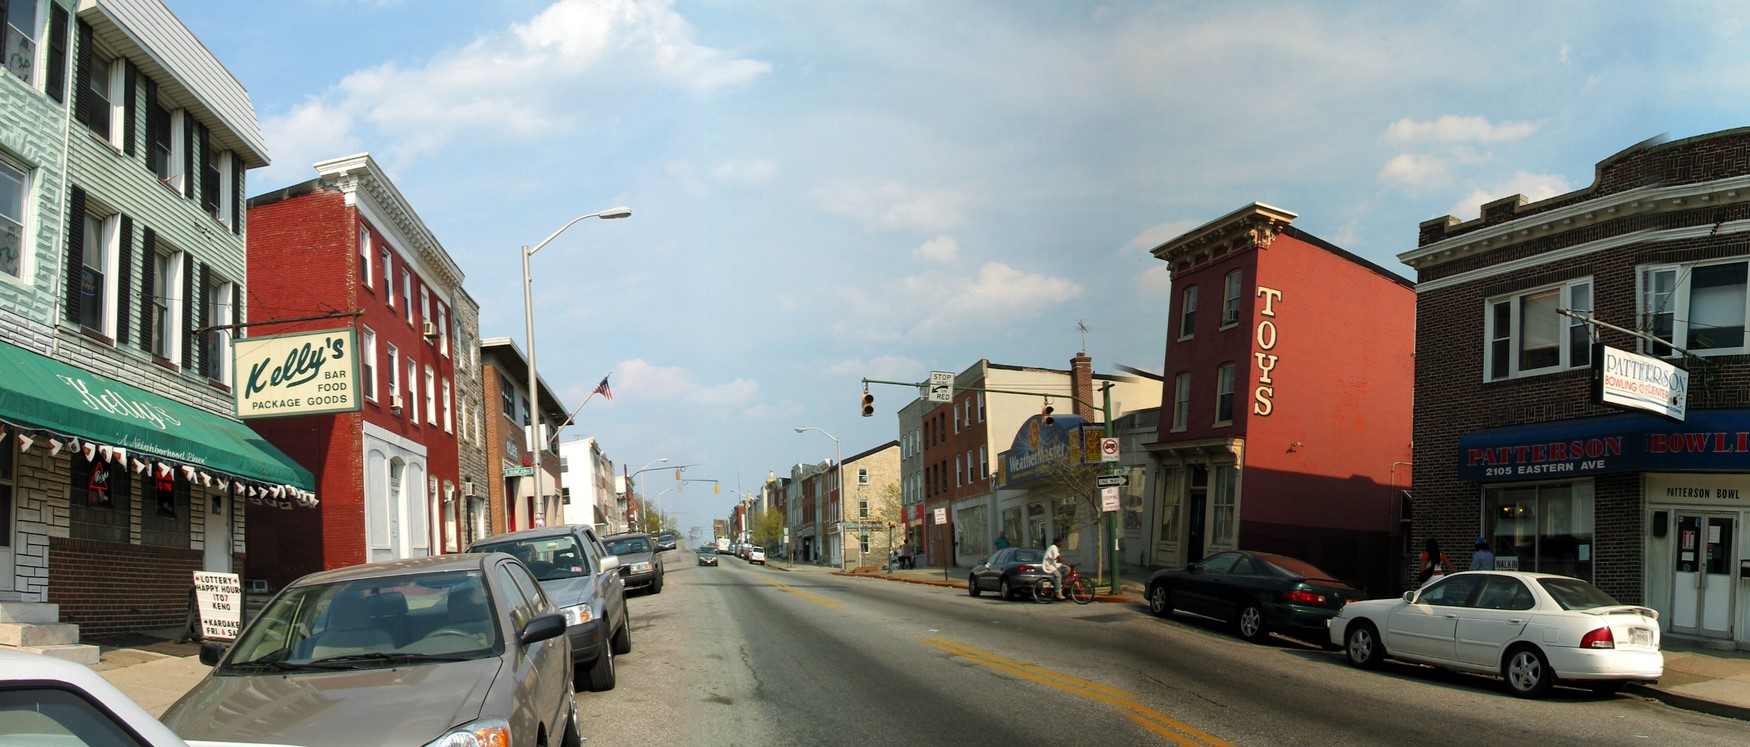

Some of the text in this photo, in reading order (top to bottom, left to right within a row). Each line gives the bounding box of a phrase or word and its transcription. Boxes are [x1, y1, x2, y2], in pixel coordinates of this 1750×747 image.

[1254, 285, 1282, 417] TOYS
[245, 337, 344, 399] Kelly's
[324, 370, 346, 379] BAR
[318, 383, 347, 392] FOOD
[1605, 375, 1637, 391] BOWLING
[252, 394, 347, 410] PACKAGE GOODS
[130, 437, 186, 461] Neighborhood
[1467, 436, 1623, 466] PATTERSON
[1485, 460, 1605, 476] 2105 EASTERN AVE
[1666, 487, 1740, 499] PATTERSON BOWL
[196, 584, 218, 592] HAPPY
[200, 576, 232, 584] LOTTERY
